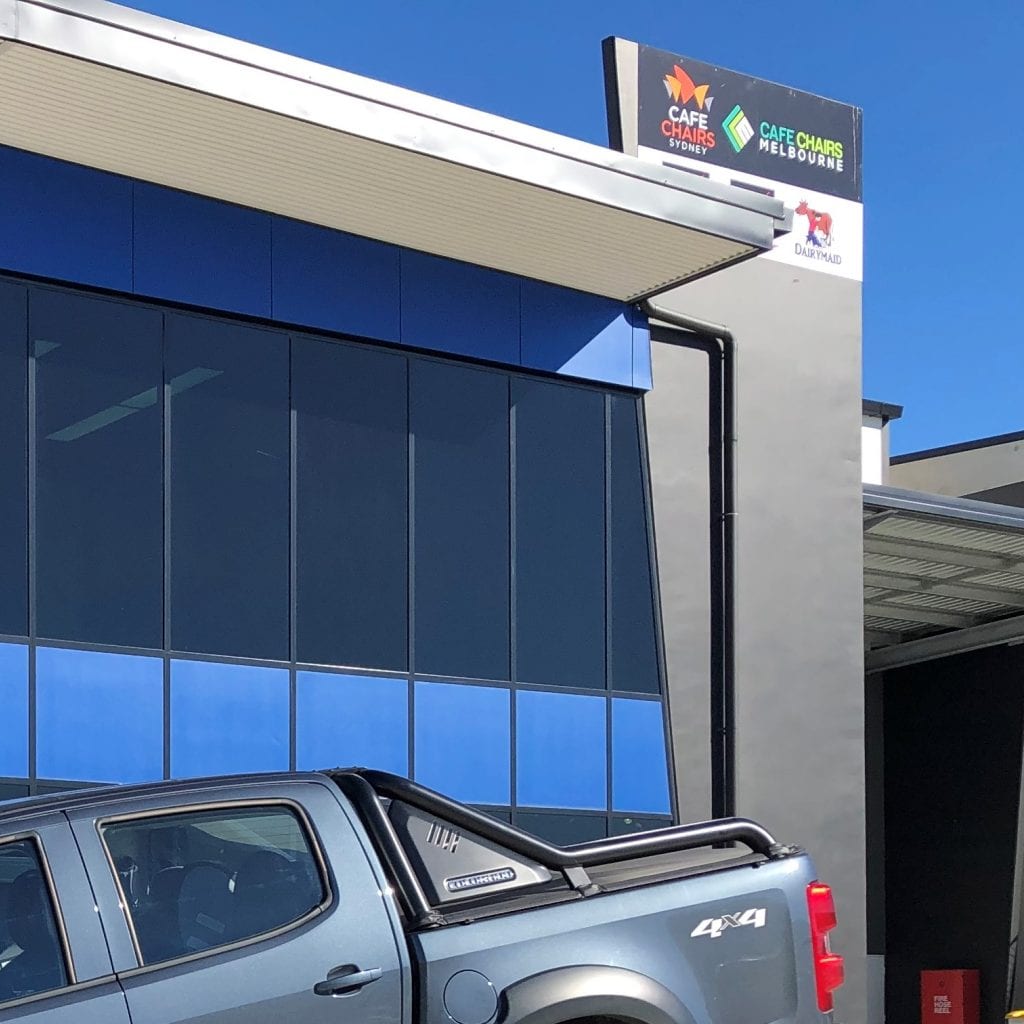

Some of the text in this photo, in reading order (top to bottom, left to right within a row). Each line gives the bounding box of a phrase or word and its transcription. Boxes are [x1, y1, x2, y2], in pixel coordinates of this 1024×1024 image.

[668, 105, 708, 130] CAFE
[661, 119, 716, 148] CHAIRS
[669, 138, 708, 155] SYDNEY
[760, 121, 843, 159] CAFE CHAIRS
[759, 137, 844, 172] MELBOURNE
[794, 242, 842, 265] DAIRYMAID
